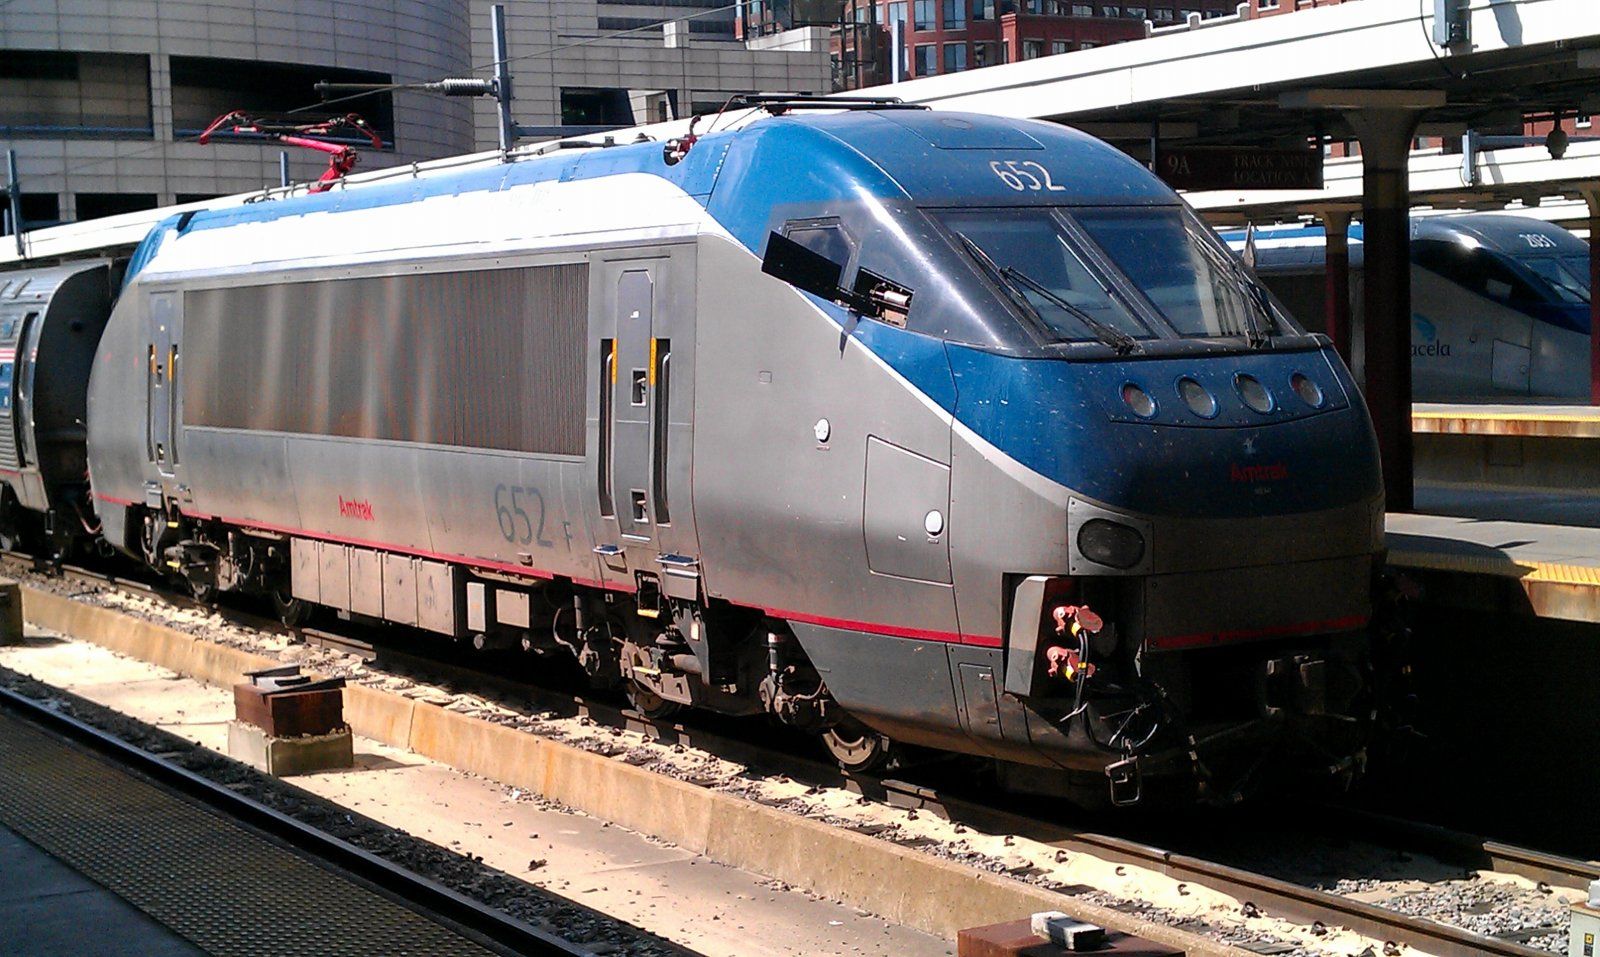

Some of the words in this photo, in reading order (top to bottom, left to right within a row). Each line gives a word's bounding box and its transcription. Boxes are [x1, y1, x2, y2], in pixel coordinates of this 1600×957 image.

[1168, 155, 1191, 174] 9A
[1234, 154, 1275, 168] TRACK
[1281, 155, 1312, 168] NINE
[989, 160, 1066, 191] 652
[1234, 171, 1297, 184] LOCATION
[1518, 233, 1557, 248] 2031
[1410, 338, 1451, 357] acela
[1231, 462, 1288, 482] Amtrak
[339, 494, 375, 521] Amtrak
[494, 483, 554, 548] 652
[562, 521, 573, 553] F
